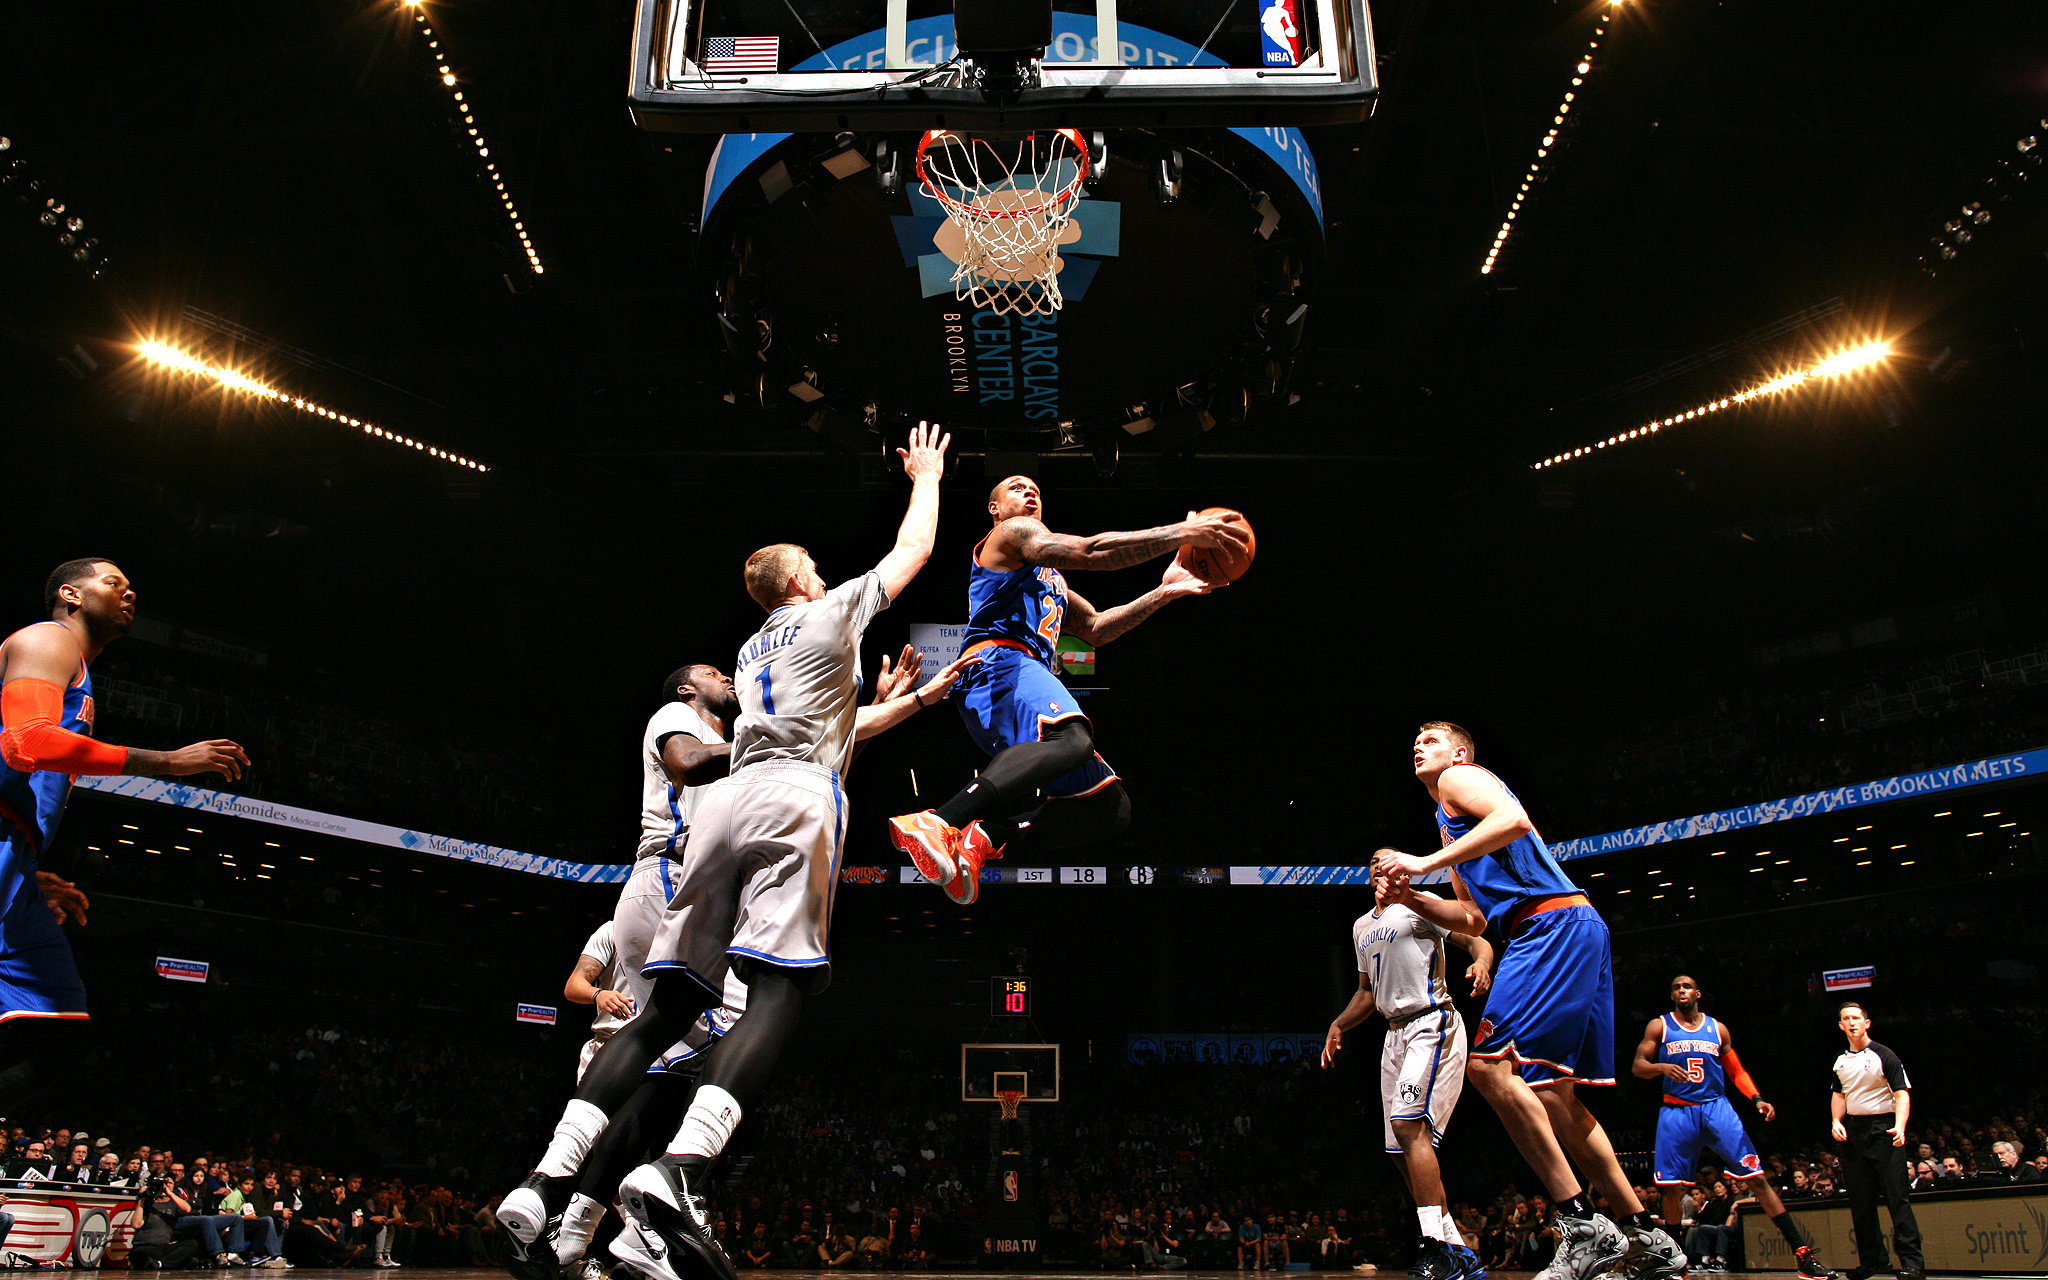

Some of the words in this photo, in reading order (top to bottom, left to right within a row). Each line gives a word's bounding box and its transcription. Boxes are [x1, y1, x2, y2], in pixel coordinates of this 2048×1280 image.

[1266, 52, 1289, 63] NBA
[943, 313, 969, 392] BROOKLYN
[971, 310, 1014, 404] CENTER
[1020, 308, 1059, 419] BARCLAYS
[939, 628, 958, 638] TEAM
[755, 665, 776, 715] 1
[1861, 767, 1968, 801] BROOKLYN
[845, 866, 885, 881] KNICKS
[1024, 871, 1044, 881] 1ST
[1073, 868, 1095, 883] 18
[1372, 952, 1381, 982] 7
[1005, 981, 1027, 992] 1:36
[1006, 993, 1025, 1012] 10
[1666, 1040, 1691, 1056] NEW
[1691, 1039, 1720, 1057] YORK
[1687, 1058, 1705, 1083] 5
[996, 1239, 1020, 1253] NBA
[1021, 1239, 1037, 1253] TV
[1757, 1230, 1793, 1258] Sprin
[1965, 1222, 2030, 1263] Sprint
